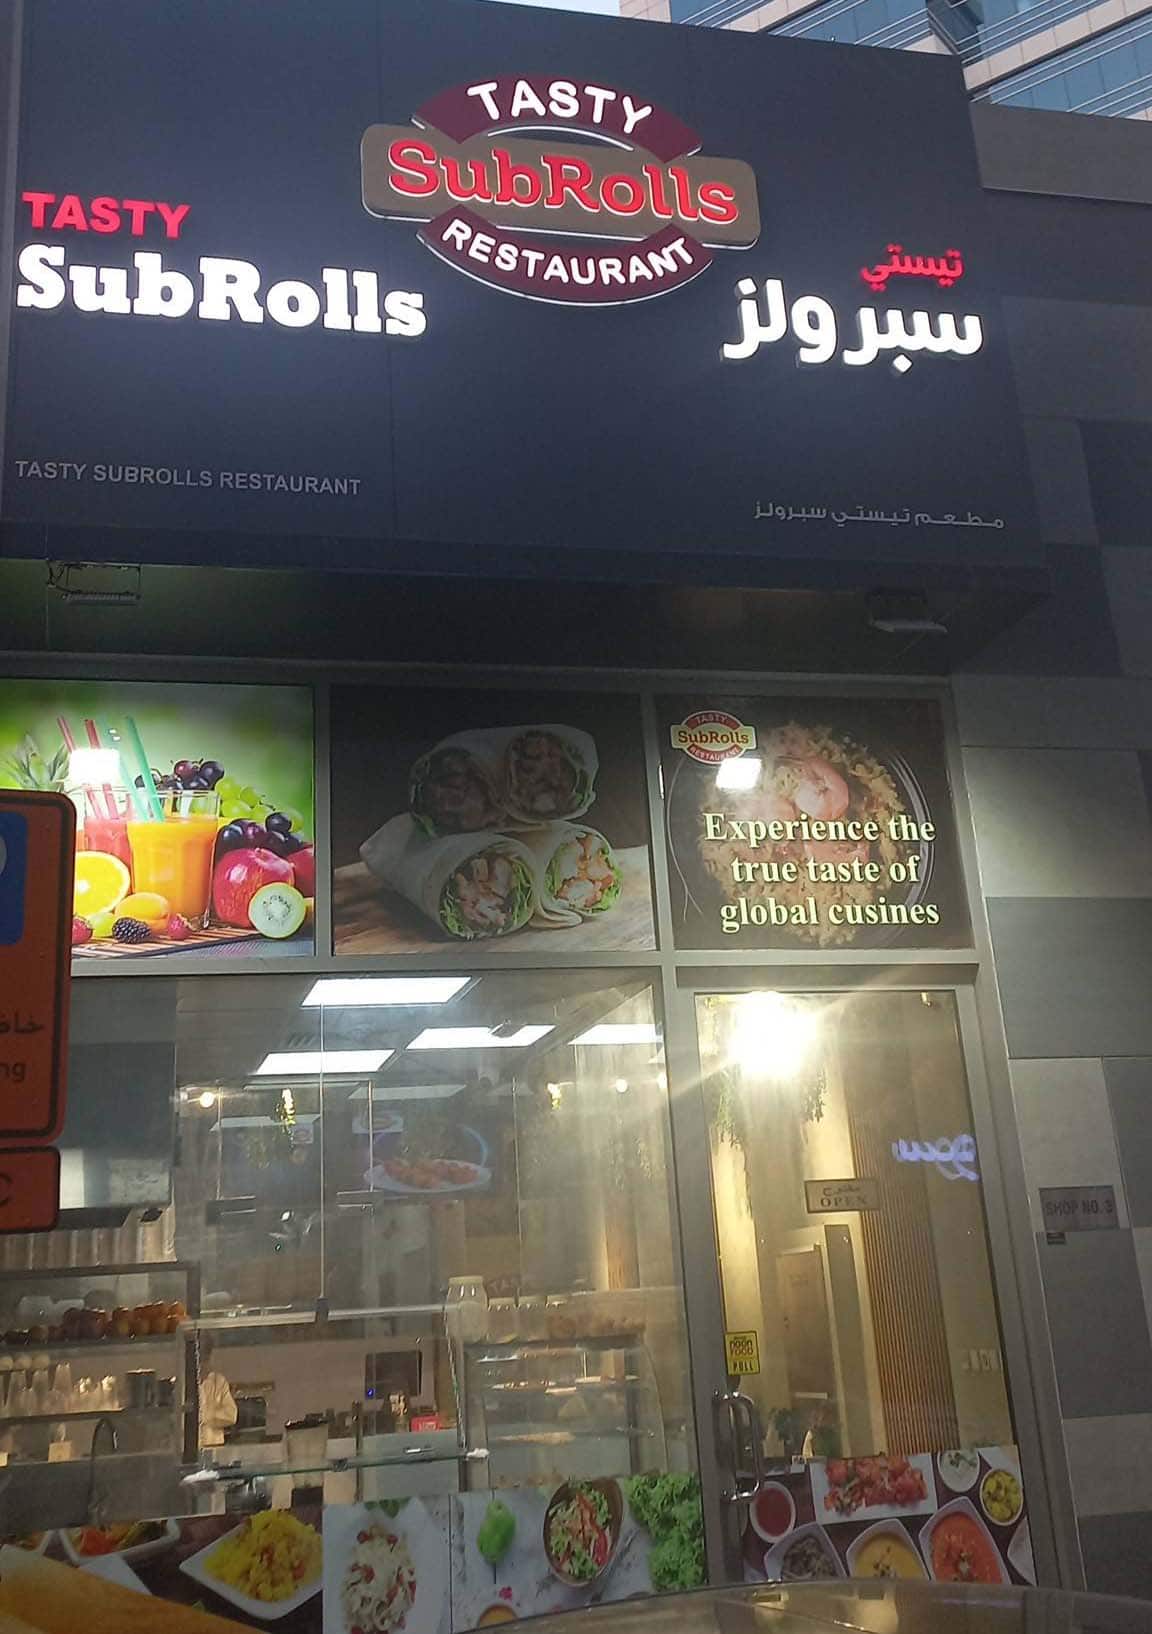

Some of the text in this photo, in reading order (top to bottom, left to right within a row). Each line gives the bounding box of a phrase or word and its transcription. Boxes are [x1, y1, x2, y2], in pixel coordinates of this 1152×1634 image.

[467, 80, 652, 133] TASTY
[388, 138, 739, 225] SubRolls
[22, 192, 190, 239] TASTY
[442, 218, 694, 286] RESTAURANT
[861, 244, 964, 291] تيستي
[16, 243, 428, 338] SubRolls
[15, 461, 361, 495] TASTY SUBROLLS RESTAURANT
[754, 500, 1005, 528] مطعم تيستي سبرولز
[678, 730, 749, 744] SubRolls
[703, 813, 936, 849] Experience the
[731, 855, 921, 883] true taste of
[720, 896, 940, 934] global cusines
